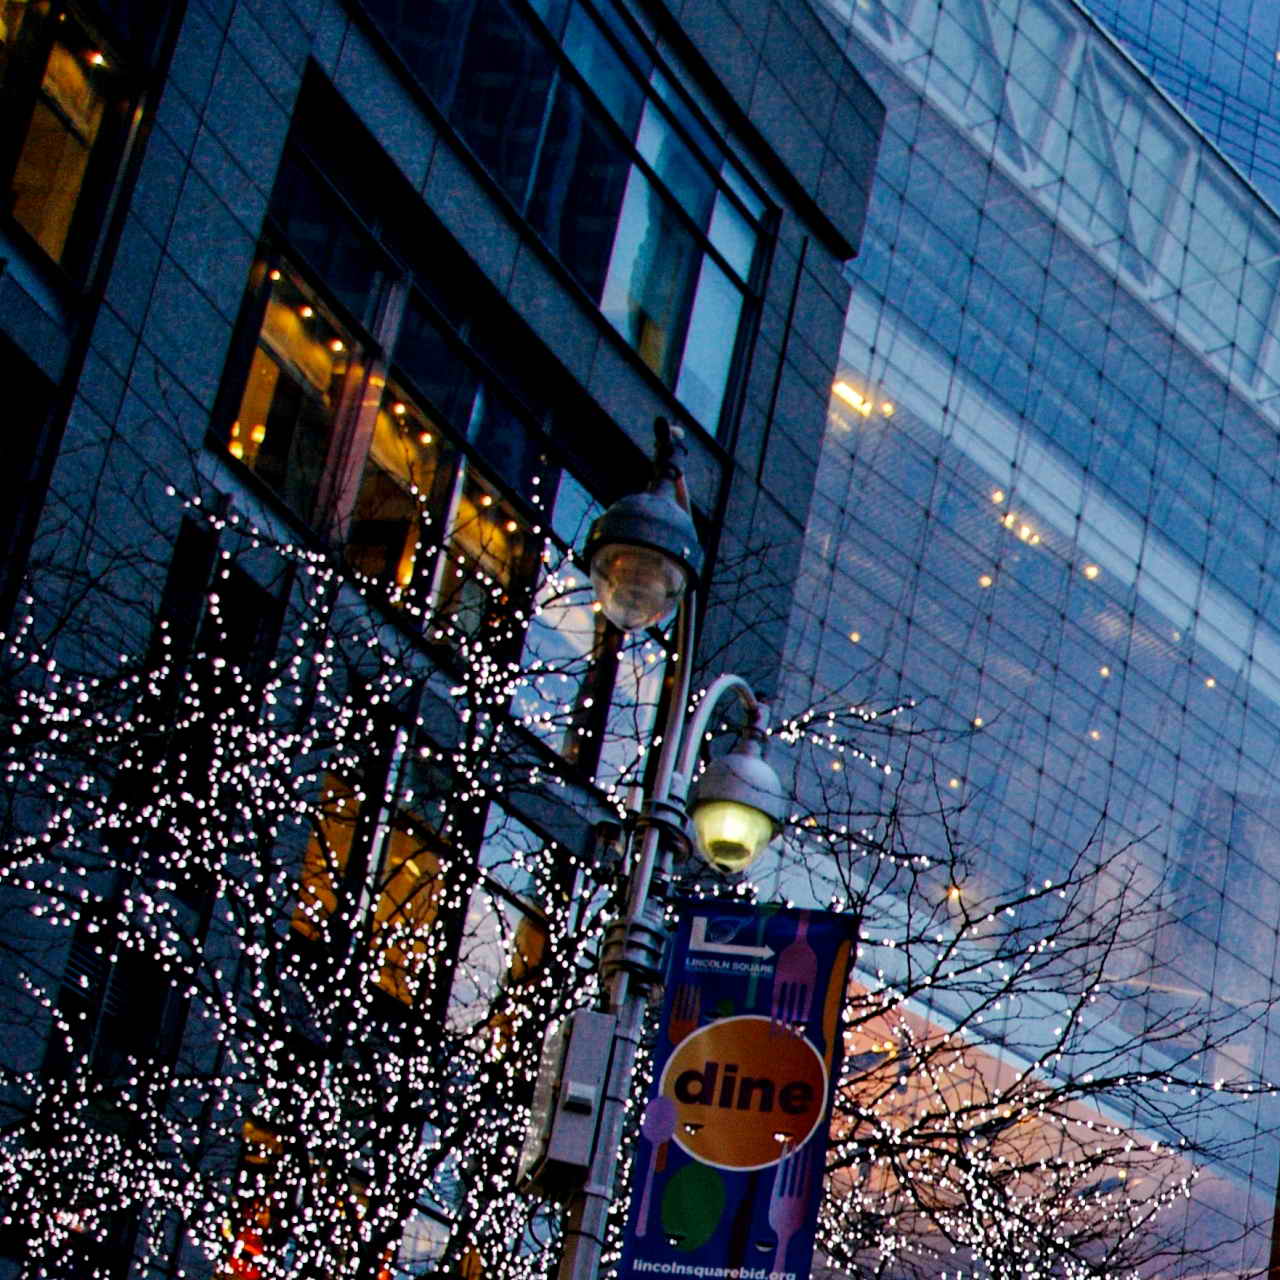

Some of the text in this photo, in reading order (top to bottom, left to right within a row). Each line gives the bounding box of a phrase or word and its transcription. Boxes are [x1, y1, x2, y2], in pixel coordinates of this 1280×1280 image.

[685, 956, 774, 974] LINCOLN SQUARE
[674, 1061, 813, 1115] dine
